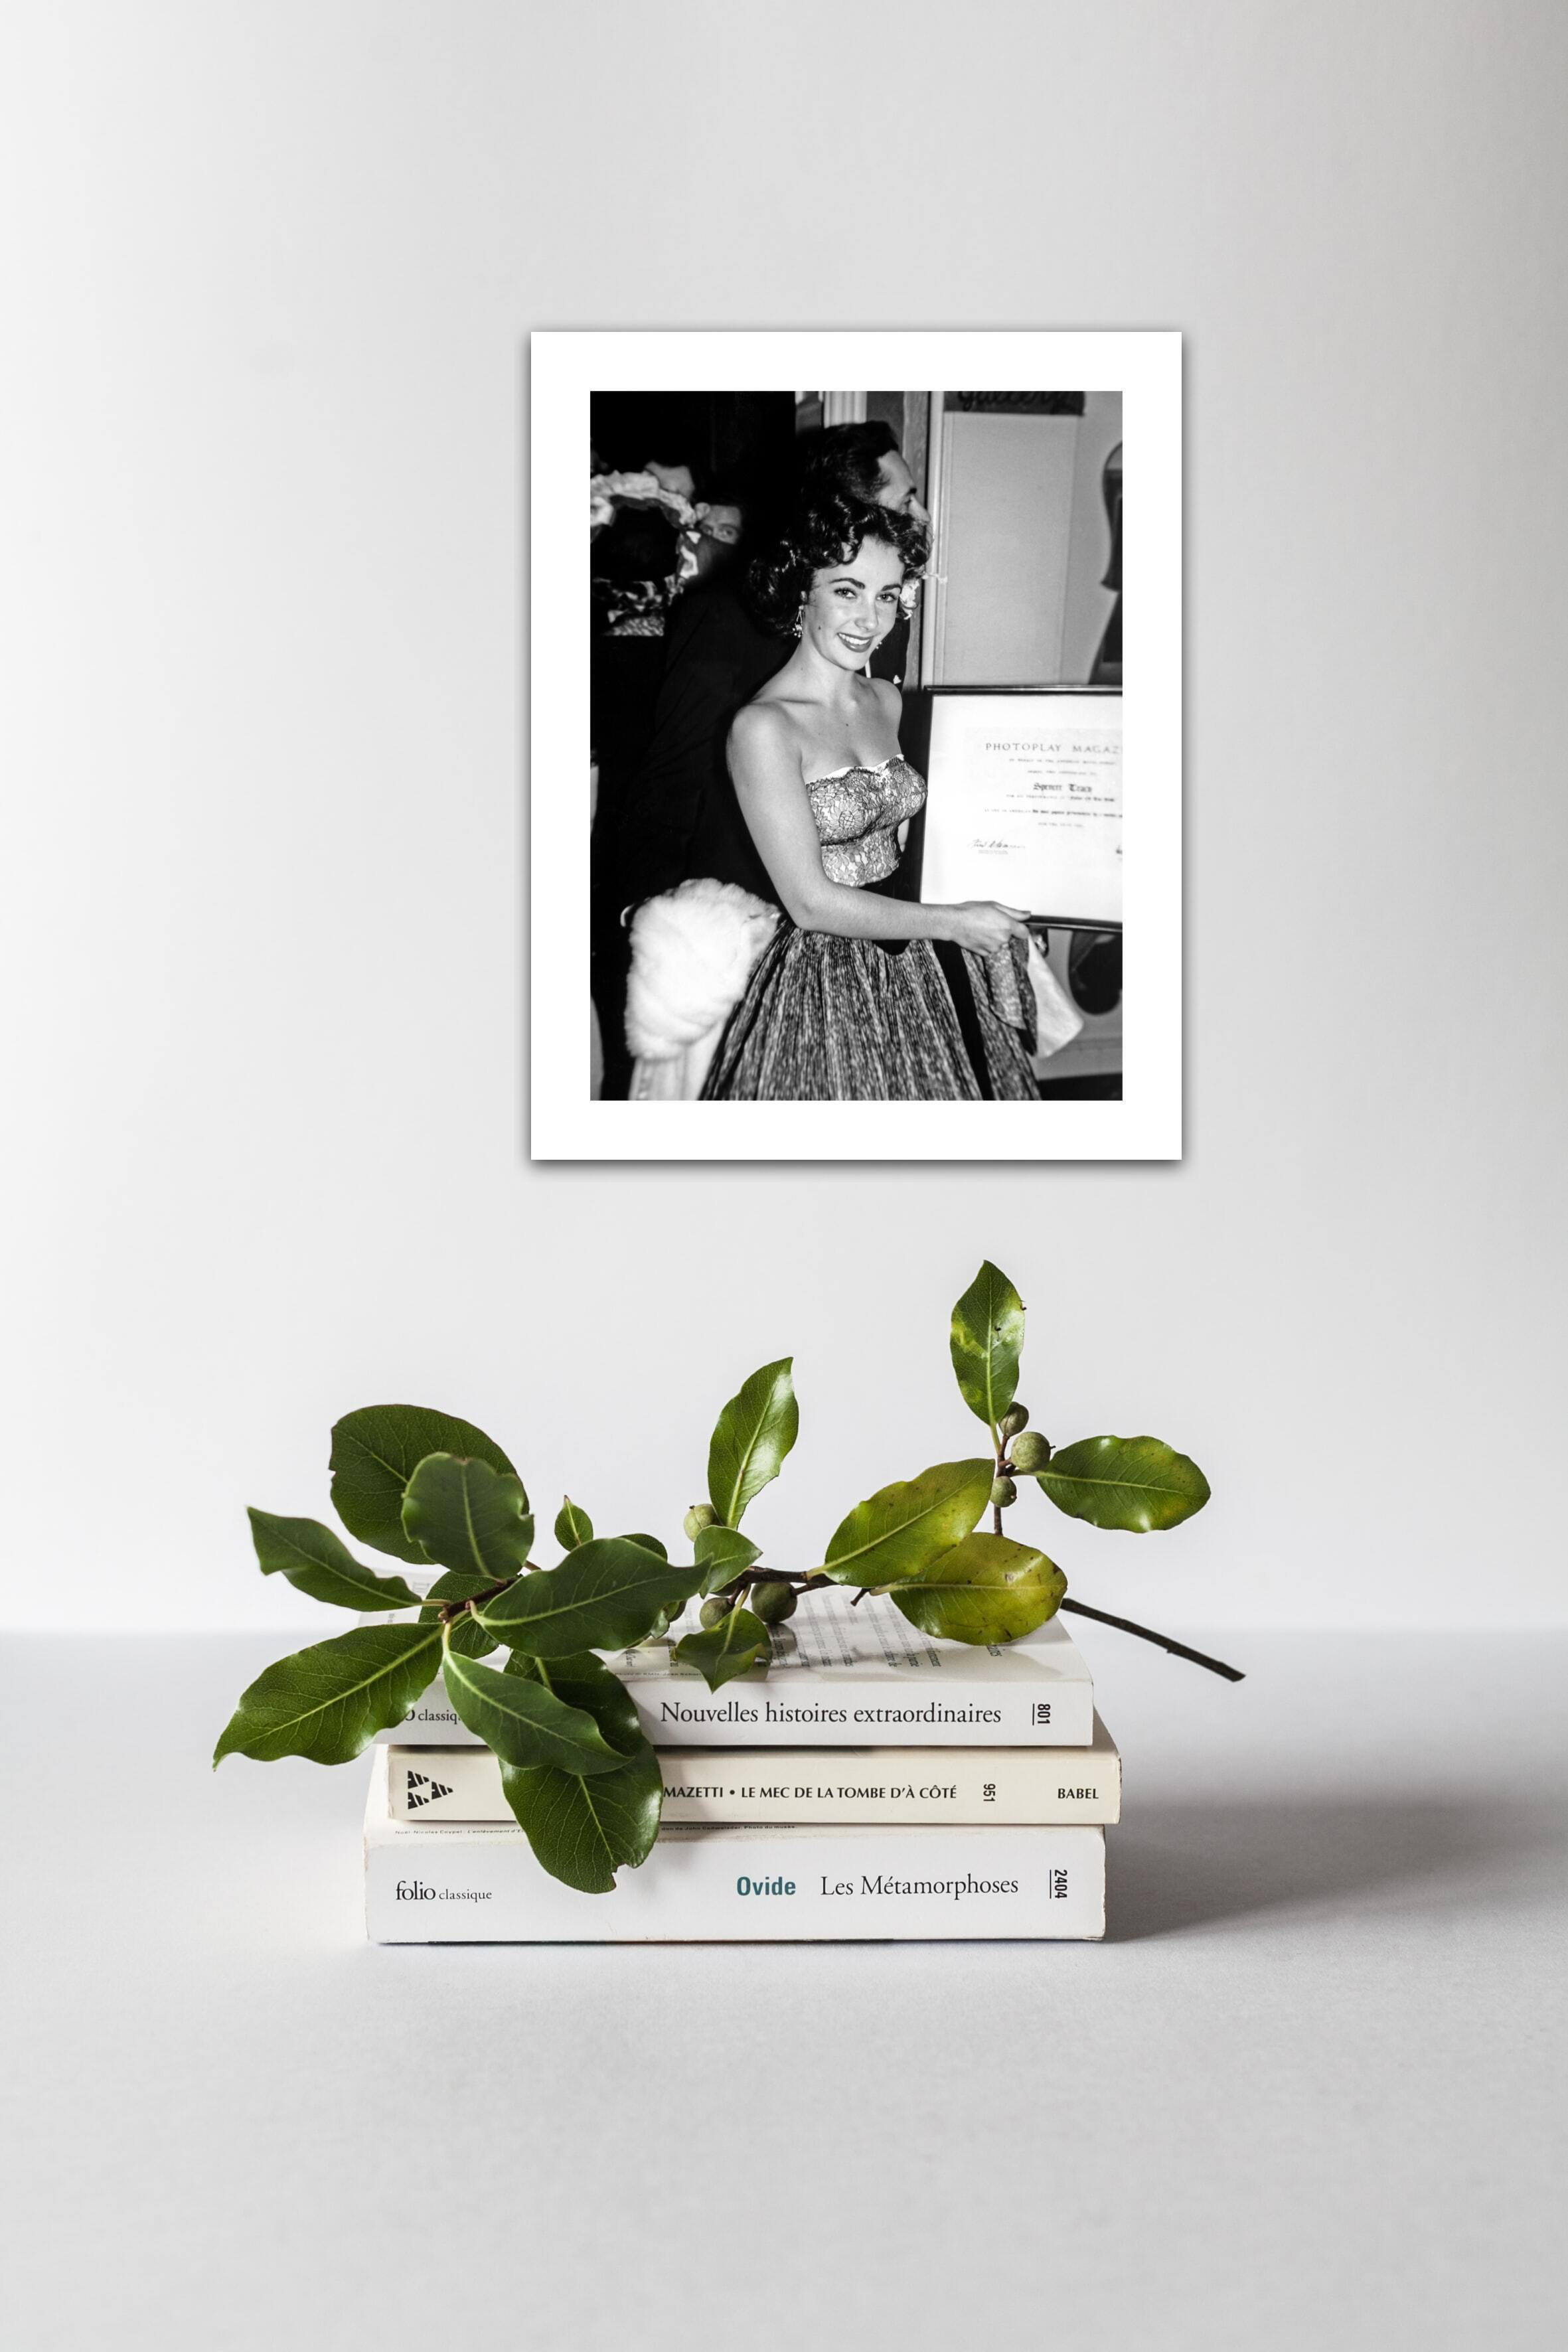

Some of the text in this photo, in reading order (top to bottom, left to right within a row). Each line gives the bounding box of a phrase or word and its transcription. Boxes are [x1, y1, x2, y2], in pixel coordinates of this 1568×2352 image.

[986, 743, 1120, 754] PHOTOPLAY MAGAZ
[418, 1709, 461, 1725] classiq
[661, 1702, 1001, 1722] Nouvelles histoires extraordinaires
[1038, 1704, 1051, 1724] 801
[663, 1787, 723, 1798] MAZETTI
[742, 1788, 755, 1798] LE
[760, 1788, 789, 1798] MEC
[795, 1788, 812, 1798] DE
[818, 1788, 834, 1798] LA
[838, 1788, 886, 1798] TOMBE
[920, 1784, 957, 1798] CÔTÉ
[983, 1784, 996, 1802] 951
[1058, 1788, 1099, 1799] BABEL
[396, 1881, 492, 1903] folio classique
[737, 1873, 1018, 1901] Ovide Les Métamorphoses
[1055, 1870, 1067, 1899] 2404
